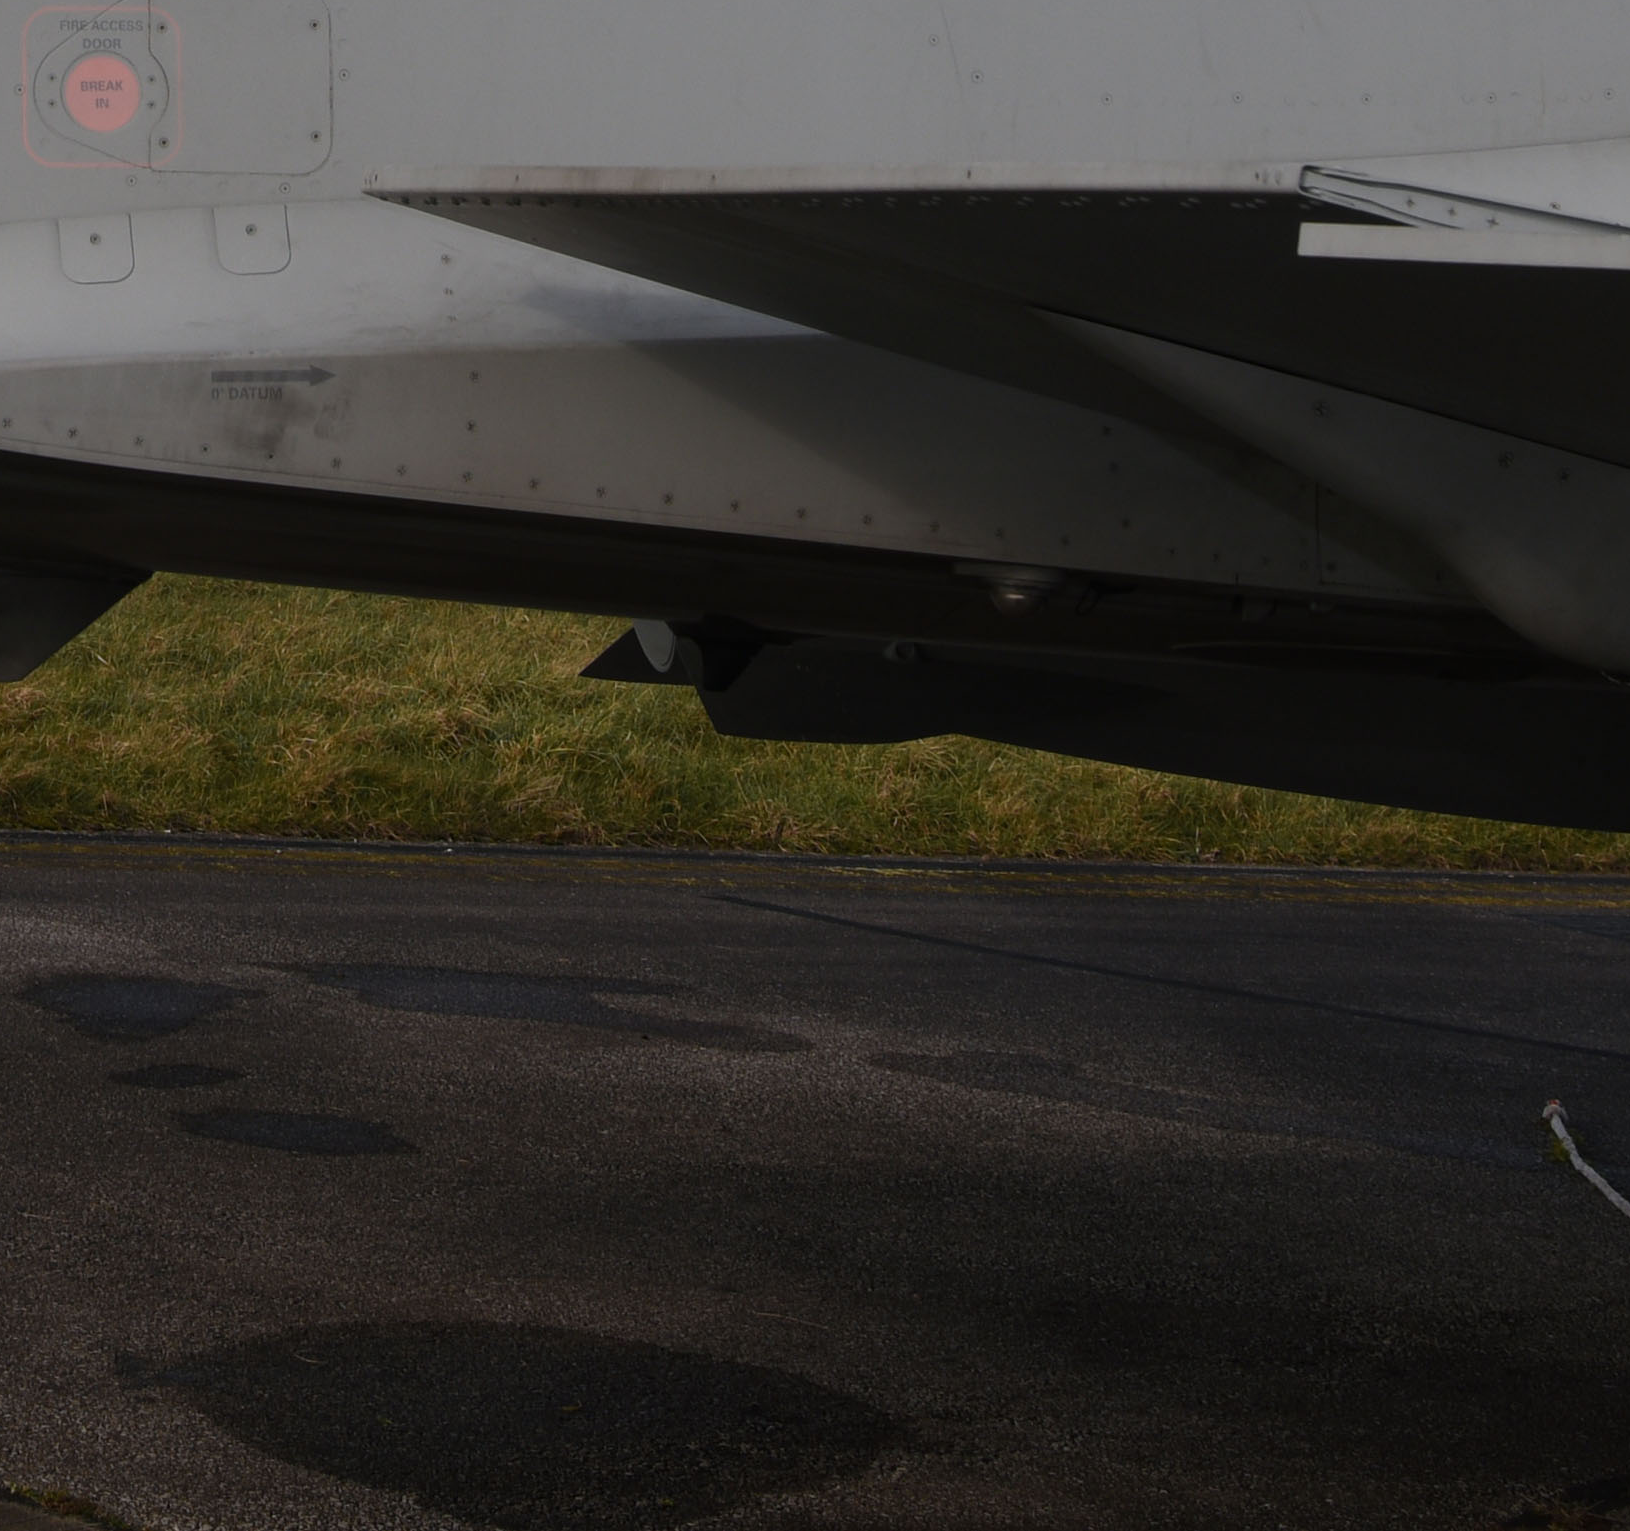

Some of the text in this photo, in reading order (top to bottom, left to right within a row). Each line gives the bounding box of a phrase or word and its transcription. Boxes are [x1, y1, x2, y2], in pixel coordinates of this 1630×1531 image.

[59, 19, 144, 33] FIRE ACCESS
[82, 38, 122, 50] DOOR
[80, 80, 123, 92] BREAK
[95, 98, 109, 109] IN
[229, 386, 283, 401] DATUM
